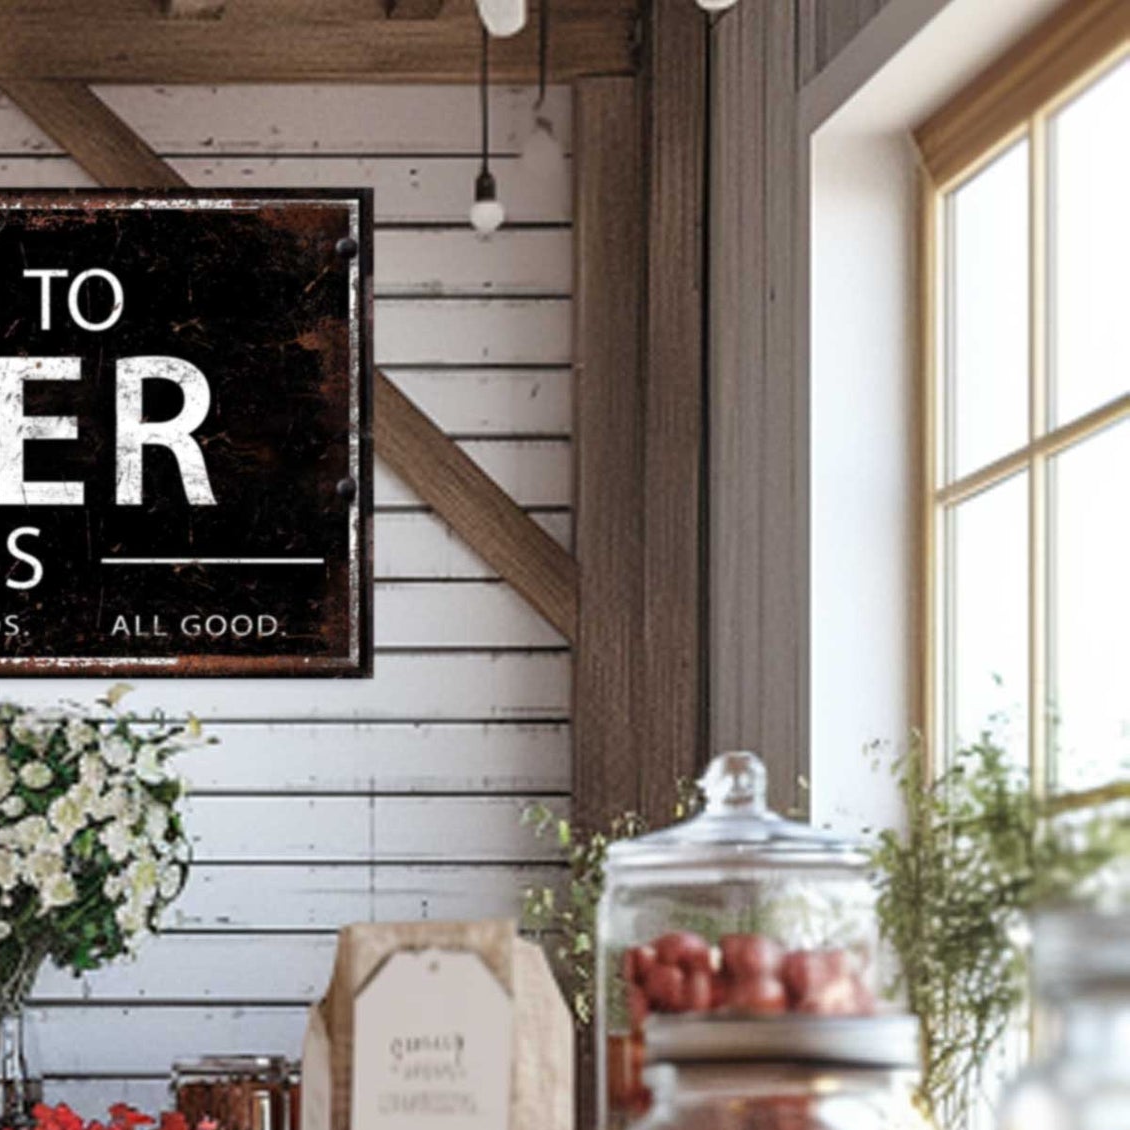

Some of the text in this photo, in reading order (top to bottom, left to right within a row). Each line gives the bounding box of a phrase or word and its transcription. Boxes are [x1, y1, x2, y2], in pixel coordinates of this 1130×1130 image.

[22, 268, 124, 332] TO
[111, 615, 168, 637] ALL
[180, 614, 288, 637] GOOD.
